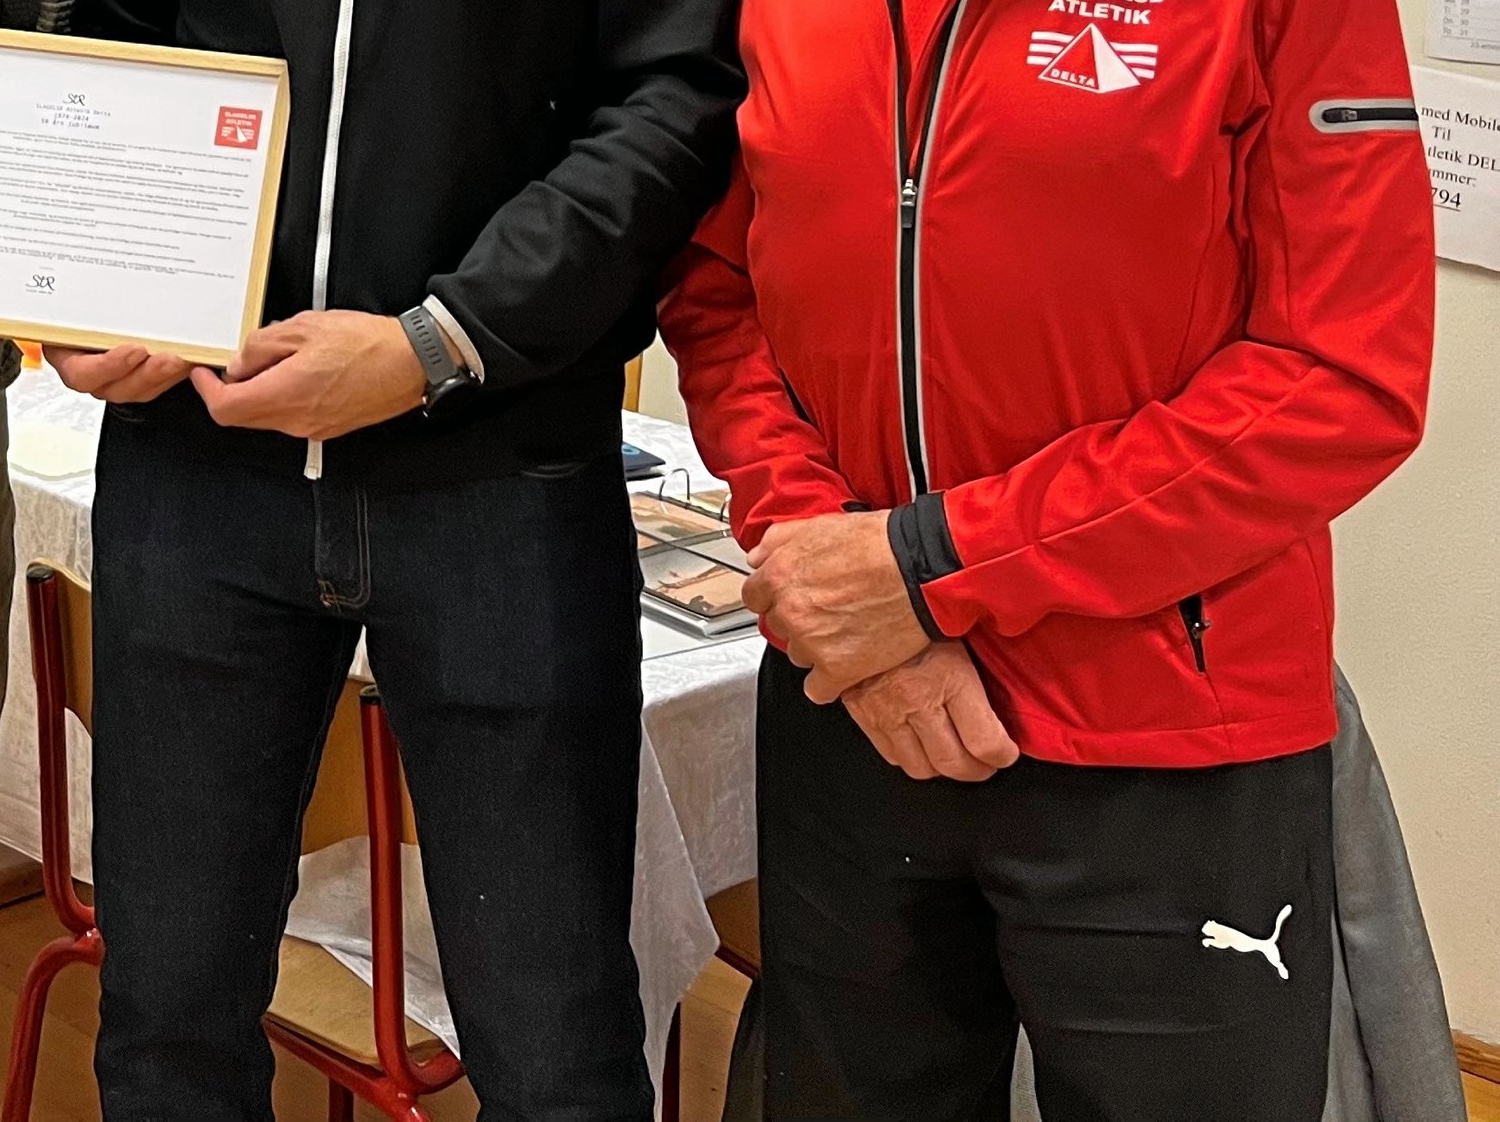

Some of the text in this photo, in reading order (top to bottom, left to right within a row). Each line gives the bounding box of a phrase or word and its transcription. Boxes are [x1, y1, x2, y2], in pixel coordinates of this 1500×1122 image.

[1050, 68, 1096, 88] DELTA
[1421, 106, 1451, 121] med
[1432, 125, 1451, 141] Til
[1427, 145, 1462, 164] tletik
